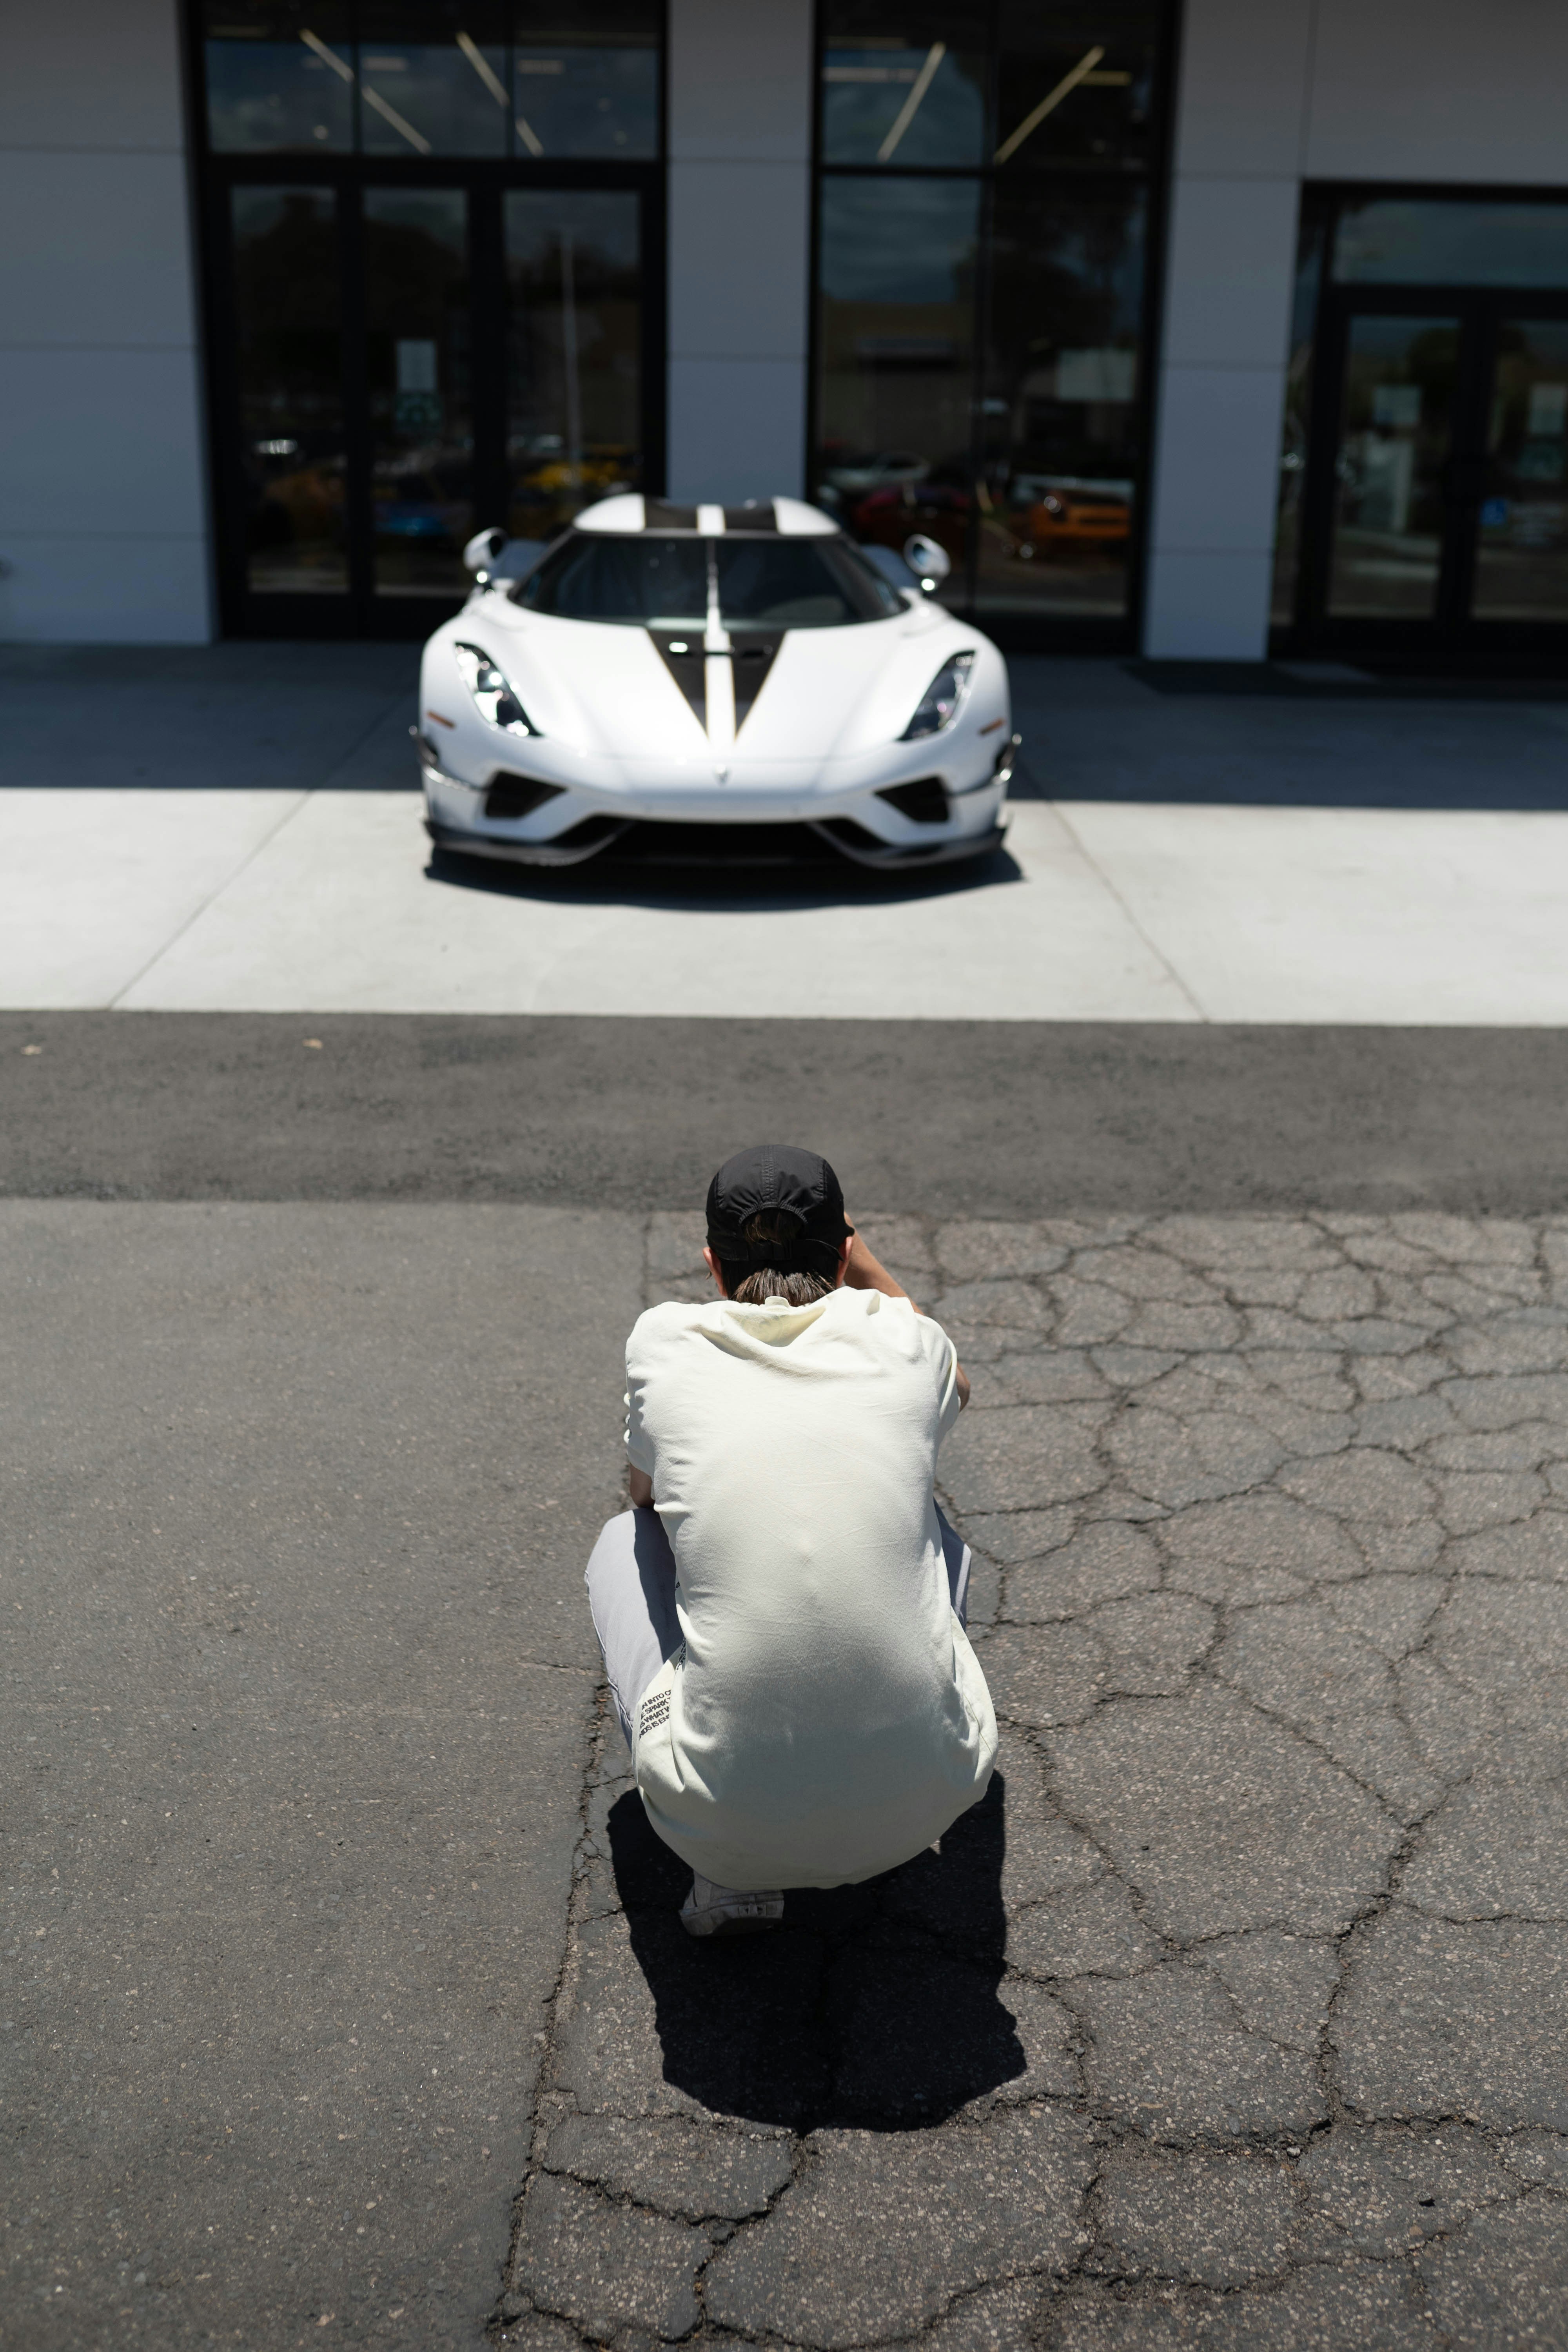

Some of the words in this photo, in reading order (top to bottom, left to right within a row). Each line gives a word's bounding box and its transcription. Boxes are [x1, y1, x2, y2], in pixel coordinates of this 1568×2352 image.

[648, 1693, 664, 1704] INTO
[645, 1699, 669, 1714] SPARK
[644, 1709, 664, 1722] WHAT
